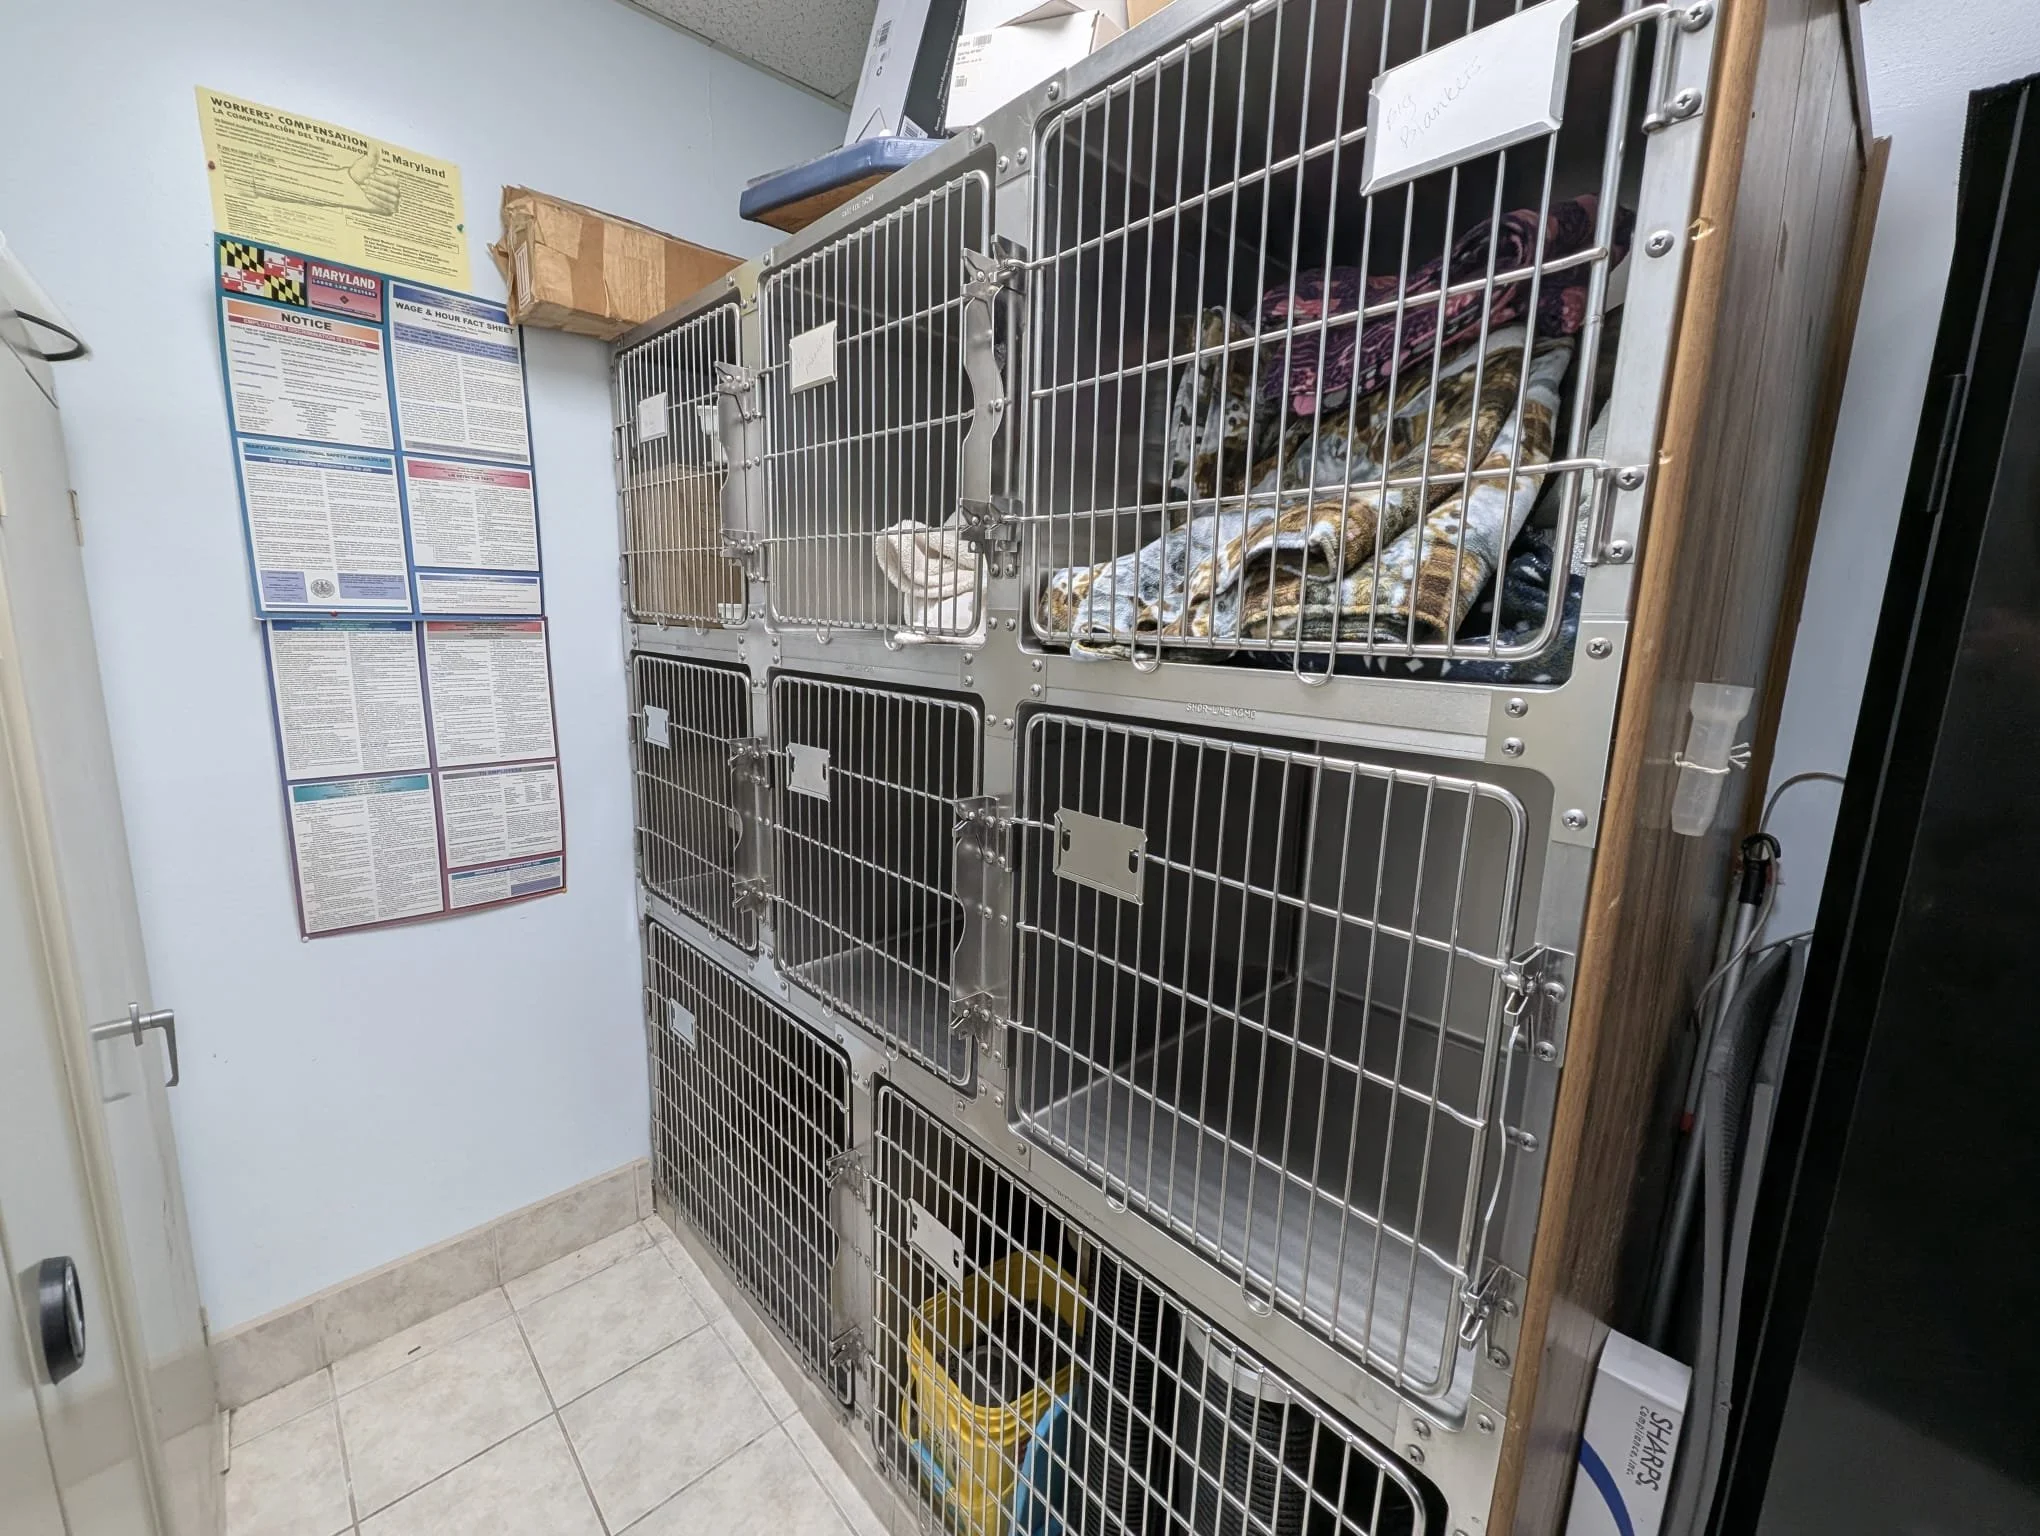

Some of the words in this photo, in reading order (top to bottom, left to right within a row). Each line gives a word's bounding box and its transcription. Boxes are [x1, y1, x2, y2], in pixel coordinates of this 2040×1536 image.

[210, 96, 274, 120] WORKERS'
[278, 115, 368, 149] COMPENSATION
[212, 107, 224, 115] LA
[226, 111, 296, 135] COMPENSACIÓN
[297, 130, 313, 140] DEL
[315, 135, 369, 156] TRABAJADOR
[392, 154, 446, 179] Maryland
[311, 265, 376, 290] MARYLAND
[312, 279, 333, 287] LABOR
[349, 287, 376, 297] POSTERS
[281, 312, 332, 331] NOTICE
[395, 301, 423, 314] WAGE
[435, 311, 461, 323] HOUR
[463, 317, 484, 328] FACT
[486, 323, 515, 335] SHEET
[1637, 1411, 1673, 1492] SHARPS
